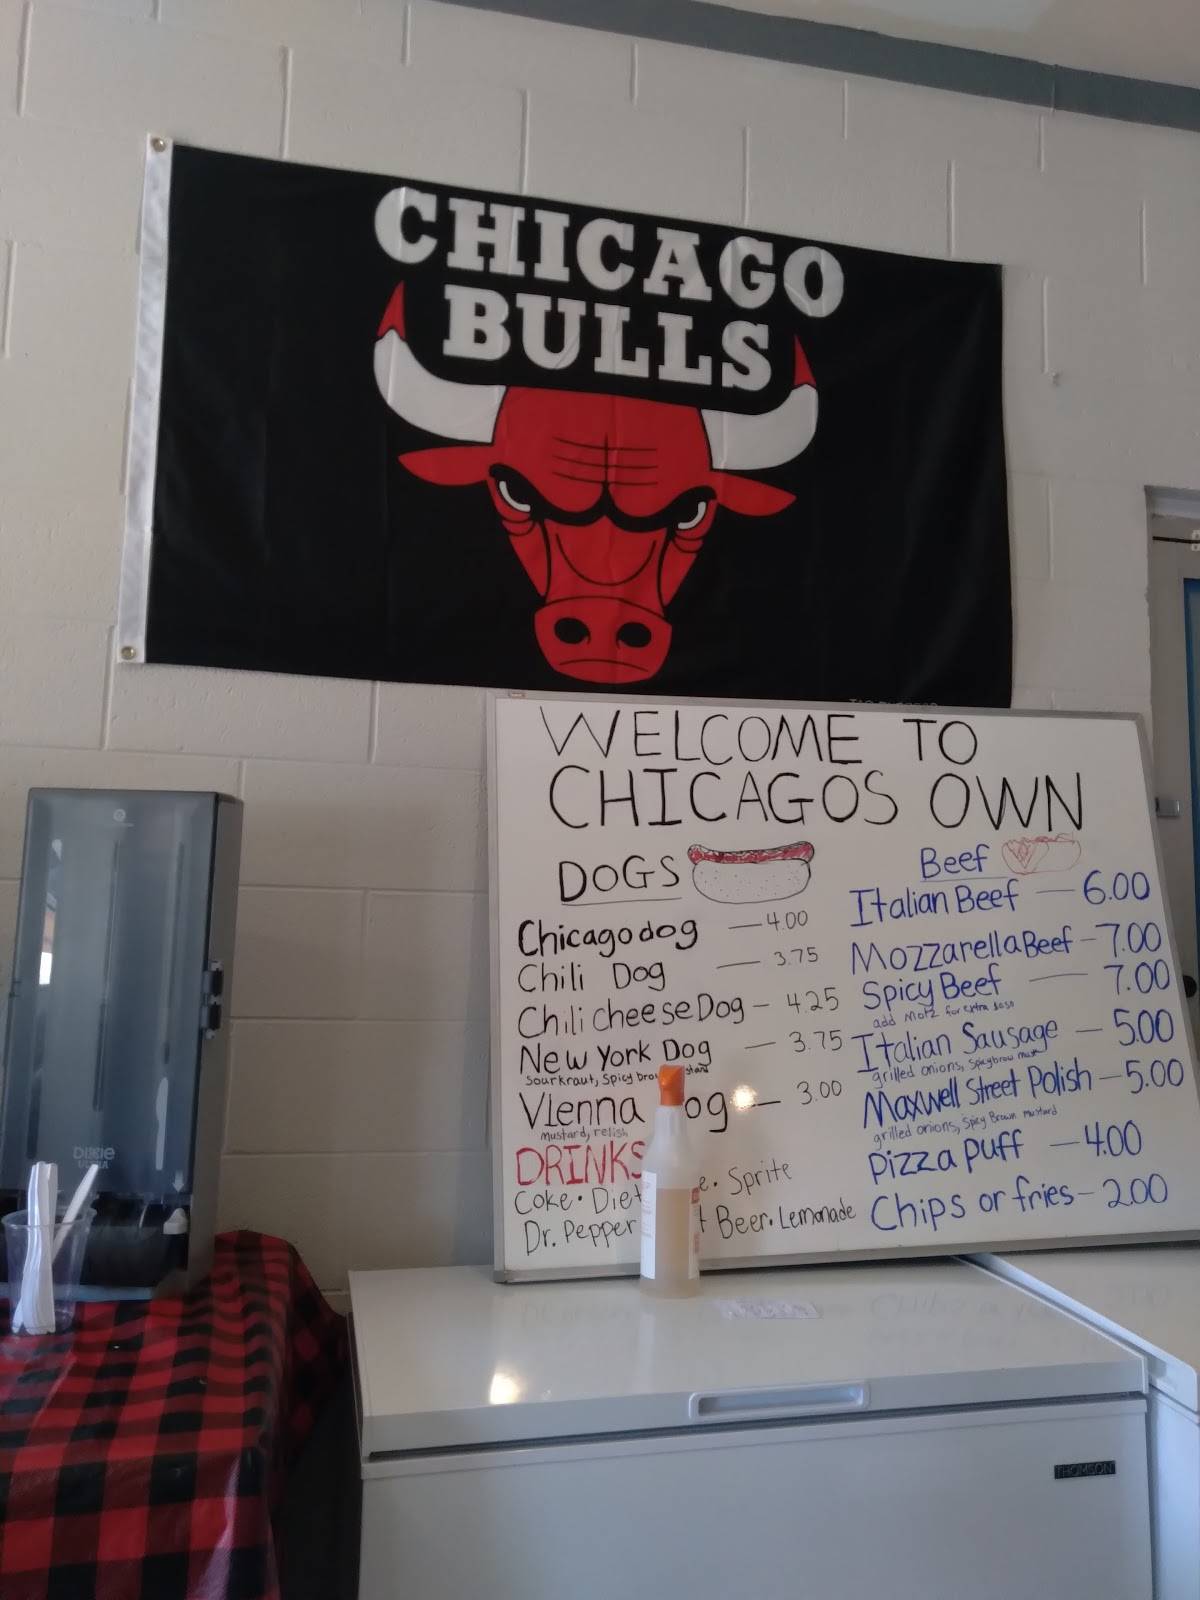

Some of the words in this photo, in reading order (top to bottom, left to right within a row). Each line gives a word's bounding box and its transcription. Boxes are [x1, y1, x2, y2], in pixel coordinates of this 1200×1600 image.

[374, 186, 844, 318] CHICAGO
[443, 283, 772, 391] BULLS
[540, 706, 863, 765] WELCOME
[903, 719, 977, 765] TO
[550, 764, 898, 829] CHICAGOS
[930, 772, 1082, 832] OWN
[558, 855, 680, 902] DOGS
[919, 843, 990, 880] Beef
[766, 910, 809, 931] 4.00
[849, 887, 949, 927] Italian
[954, 878, 1019, 914] Beef
[1083, 870, 1150, 905] 6.00
[1095, 922, 1162, 957] 7.00
[517, 962, 585, 993] Chili
[612, 961, 665, 992] Dog
[773, 946, 819, 966] 3.75
[862, 978, 934, 1012] Spicy
[940, 962, 1002, 1000] Beef
[1103, 958, 1171, 995] 7.00
[517, 1004, 585, 1039] Chili
[697, 993, 744, 1025] Dog
[786, 986, 839, 1014] 4.25
[873, 1014, 897, 1029] add
[945, 1005, 960, 1017] for
[964, 1002, 989, 1014] extra
[519, 1043, 587, 1074] New
[597, 1040, 652, 1071] York
[663, 1038, 712, 1067] Dog
[788, 1029, 843, 1053] 3.75
[851, 1030, 951, 1072] Italian
[961, 1020, 1059, 1055] Sausage
[1113, 1008, 1175, 1046] 5.00
[602, 1073, 633, 1087] Spicy
[863, 1077, 961, 1129] Maxwell
[965, 1069, 1021, 1108] Street
[1028, 1056, 1092, 1099] Polish
[1125, 1058, 1185, 1094] 5.00
[872, 1065, 915, 1089] grilled
[684, 1091, 728, 1133] og
[796, 1079, 842, 1105] 3.00
[593, 1126, 629, 1138] relish
[873, 1125, 912, 1151] grilled
[1084, 1119, 1142, 1157] 4.00
[515, 1140, 646, 1187] DRINKS
[727, 1160, 793, 1197] Sprite
[514, 1187, 573, 1215] Coke
[592, 1184, 642, 1215] Diet
[870, 1192, 966, 1232] Chips
[978, 1190, 1004, 1213] or
[1012, 1175, 1075, 1213] fries
[1102, 1173, 1169, 1209] 2.00
[524, 1219, 556, 1257] Dr.
[564, 1217, 638, 1249] Pepper
